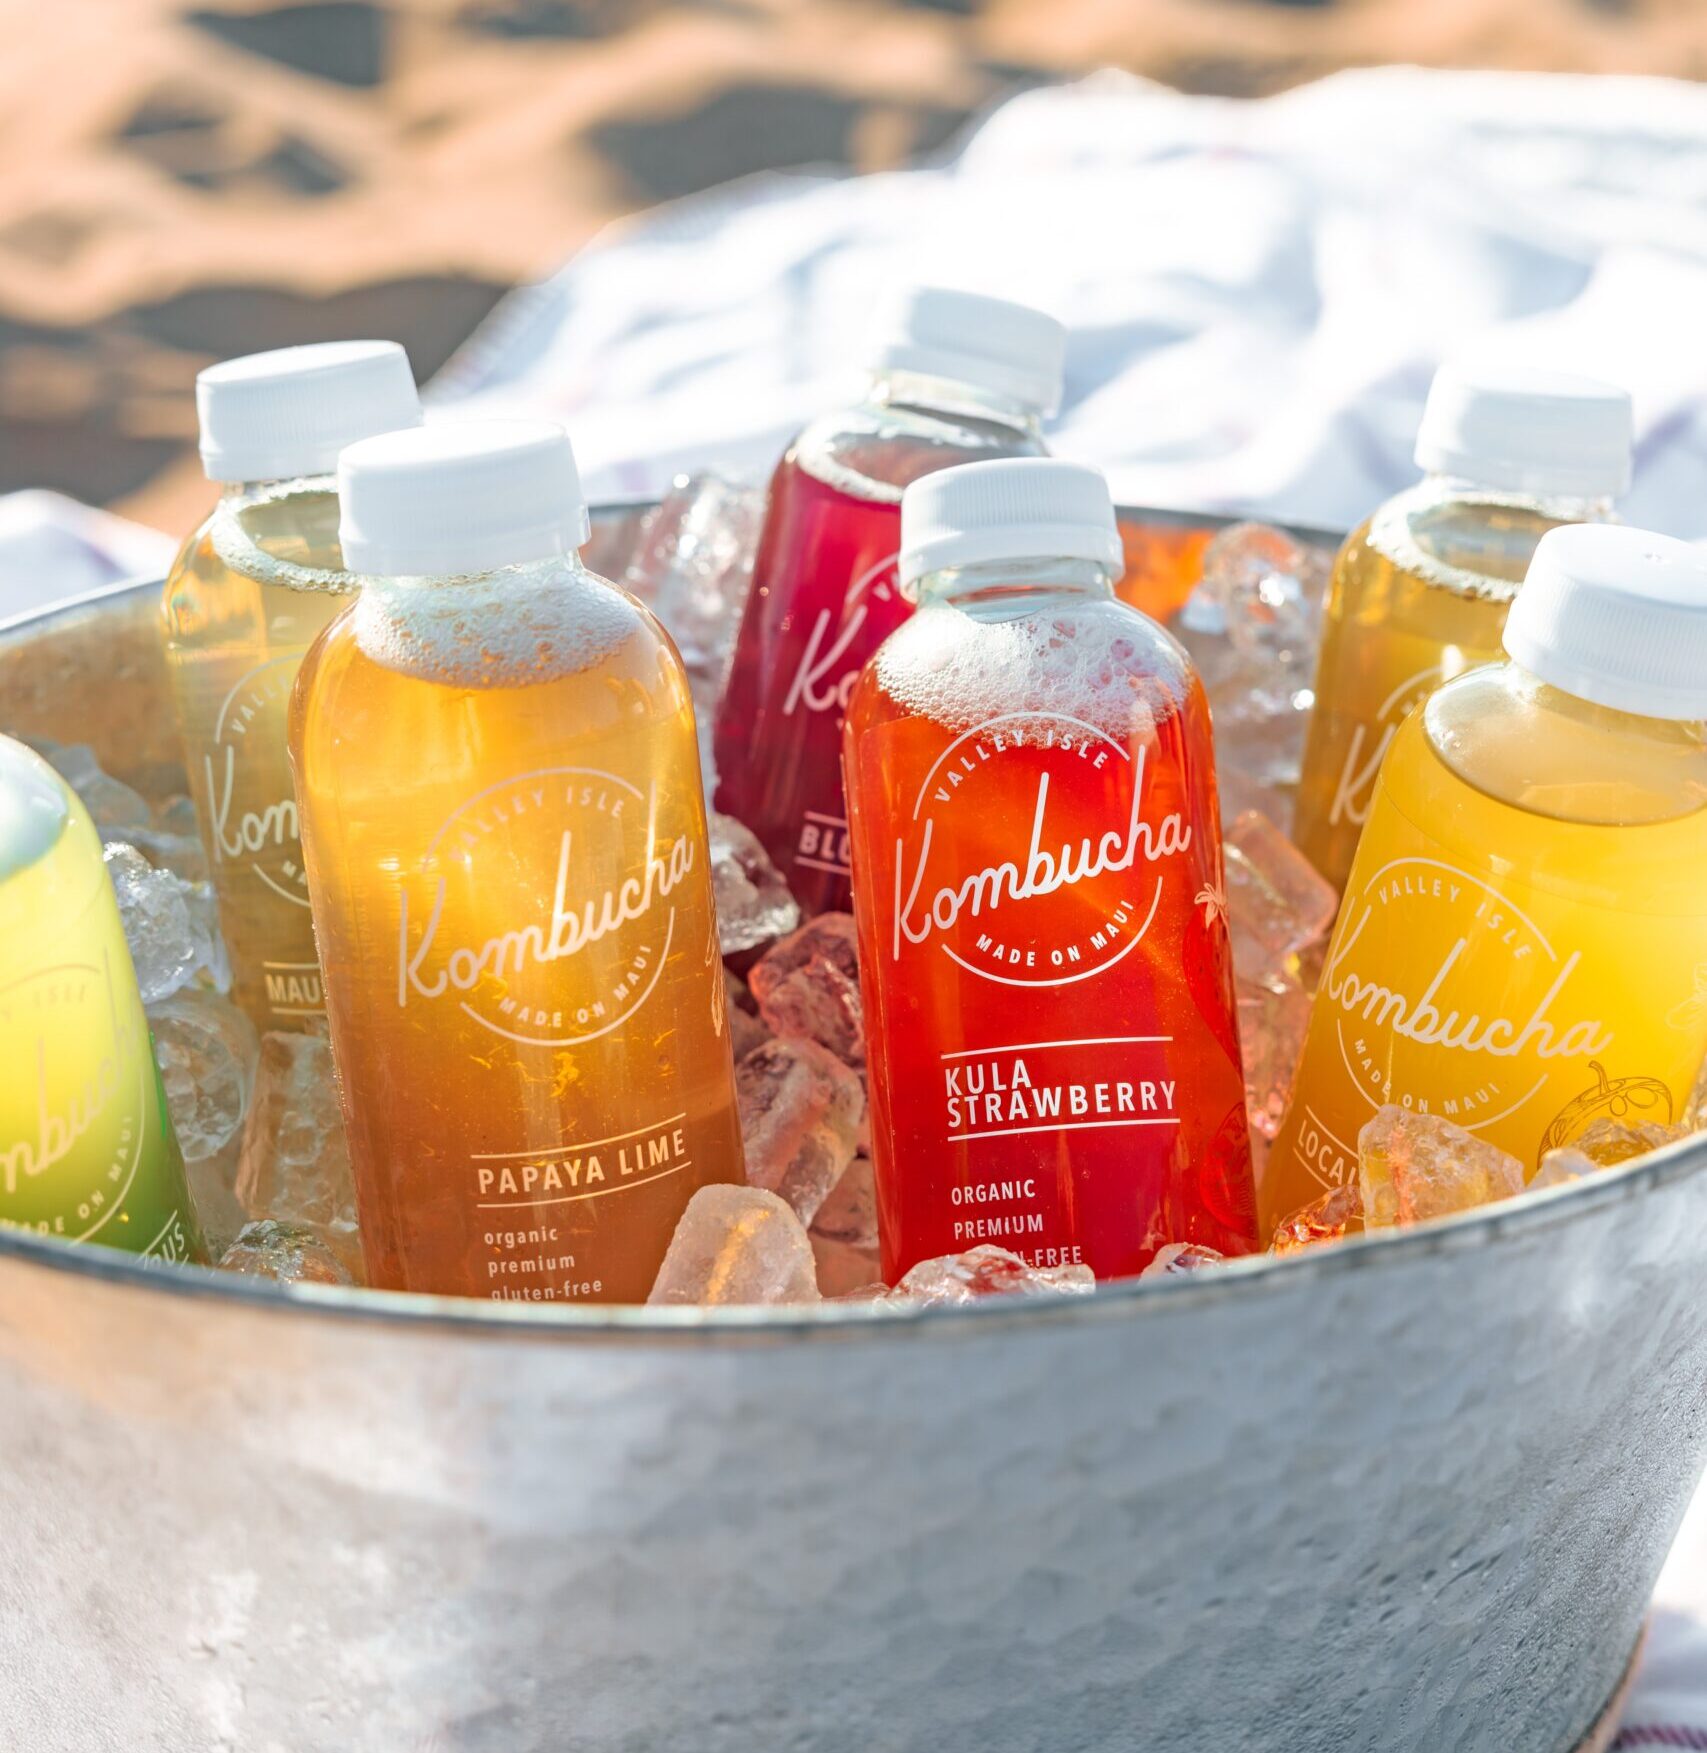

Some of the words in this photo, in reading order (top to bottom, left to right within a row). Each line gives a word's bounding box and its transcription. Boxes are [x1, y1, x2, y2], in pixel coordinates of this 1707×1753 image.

[935, 729, 1024, 804] VALLEY
[1047, 729, 1109, 769] ISLE
[449, 788, 543, 861] VALLEY
[566, 786, 624, 817] ISLE
[893, 744, 1192, 961] Kombucha
[398, 780, 694, 1006] Kombucha
[1379, 875, 1460, 905] VALLEY
[1475, 902, 1532, 959] ISLE
[975, 933, 1035, 967] MADE
[1051, 945, 1081, 966] ON
[1090, 899, 1134, 950] MAUI
[265, 974, 320, 1003] MAU
[500, 997, 562, 1027] MADE
[577, 1001, 606, 1024] ON
[613, 945, 652, 1001] MAUI
[1321, 896, 1614, 1058] Kombucha
[945, 1059, 1032, 1097] KULA
[947, 1080, 1176, 1128] STRAWBERRY
[1355, 1038, 1391, 1096] MADE
[1402, 1094, 1429, 1113] ON
[1444, 1083, 1500, 1114] MAUI
[77, 1190, 104, 1219] ON
[108, 1115, 133, 1182] MAUI
[478, 1155, 605, 1194] PAPAYA
[619, 1128, 685, 1176] LIME
[951, 1179, 1036, 1205] ORGANIC
[484, 1226, 559, 1248] organic
[953, 1213, 1043, 1240] PREMIUM
[488, 1254, 575, 1278] premium
[491, 1279, 603, 1302] gluten-free
